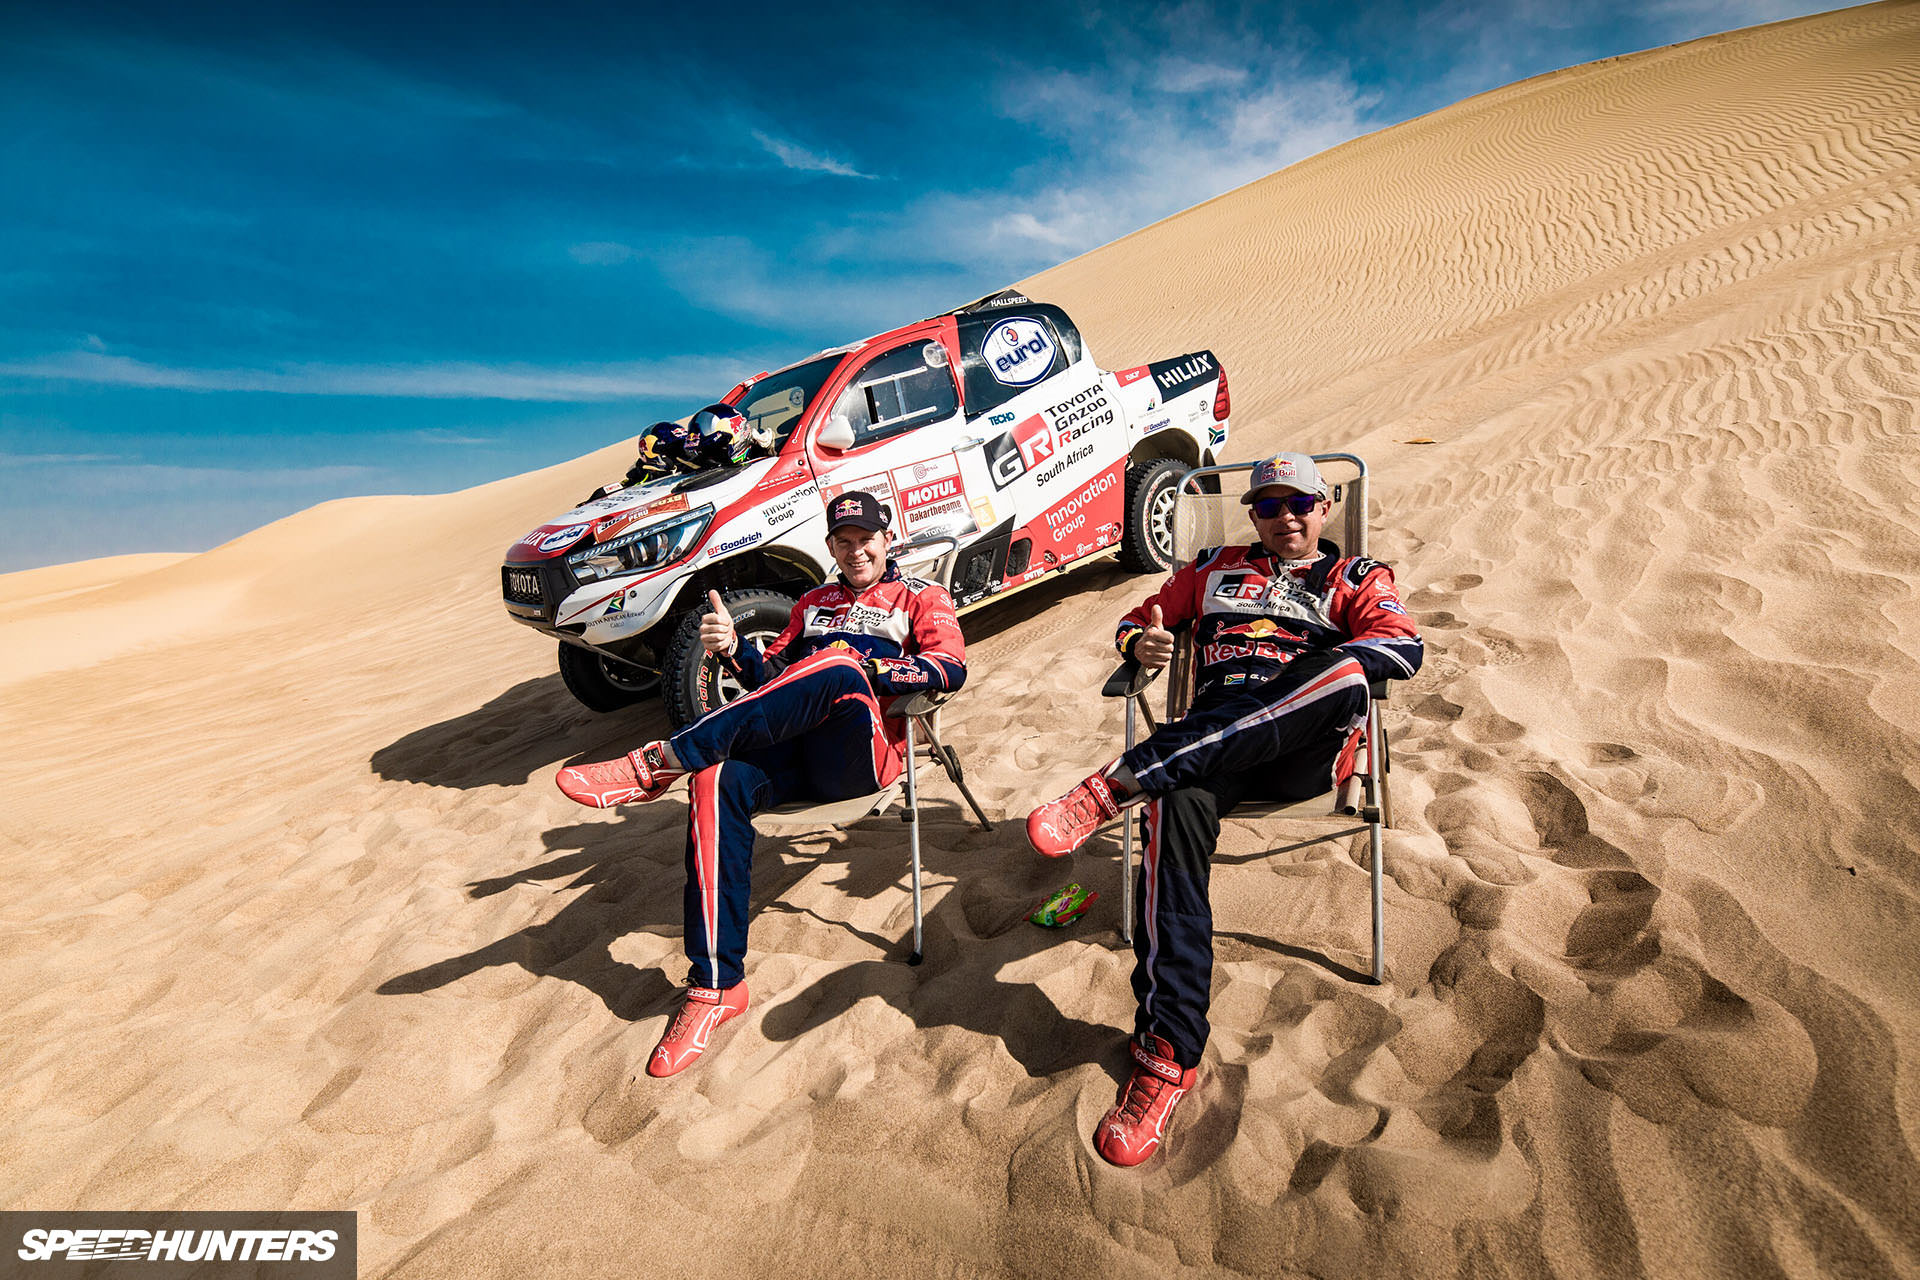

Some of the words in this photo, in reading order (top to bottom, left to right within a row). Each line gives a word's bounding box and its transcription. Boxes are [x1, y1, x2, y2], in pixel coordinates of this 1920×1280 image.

[990, 296, 1028, 307] HALLSPEED
[995, 329, 1048, 372] eurol
[1157, 353, 1213, 389] HILUX
[1044, 383, 1103, 418] TOYOTA
[1055, 397, 1107, 432] GAZOO
[1058, 409, 1114, 448] Racing
[991, 430, 1053, 487] GR
[1036, 458, 1066, 488] South
[1066, 444, 1094, 467] Africa
[1261, 471, 1277, 482] Red
[1278, 469, 1296, 477] Bull
[762, 485, 818, 518] Innovation
[907, 478, 957, 508] MOTUL
[1045, 472, 1117, 529] Innovation
[768, 509, 795, 526] Group
[909, 499, 962, 524] Dakarthegame
[1053, 513, 1086, 543] Group
[1096, 534, 1110, 547] 3M
[706, 531, 763, 557] BFGoodrich
[509, 572, 540, 595] TOYOTA
[1214, 583, 1264, 600] GR
[855, 605, 889, 622] TOYOT
[1236, 601, 1263, 609] South
[1263, 601, 1291, 612] Africa
[812, 614, 846, 628] GR
[1203, 640, 1256, 667] Red
[891, 671, 909, 683] Red
[909, 671, 928, 683] Bull
